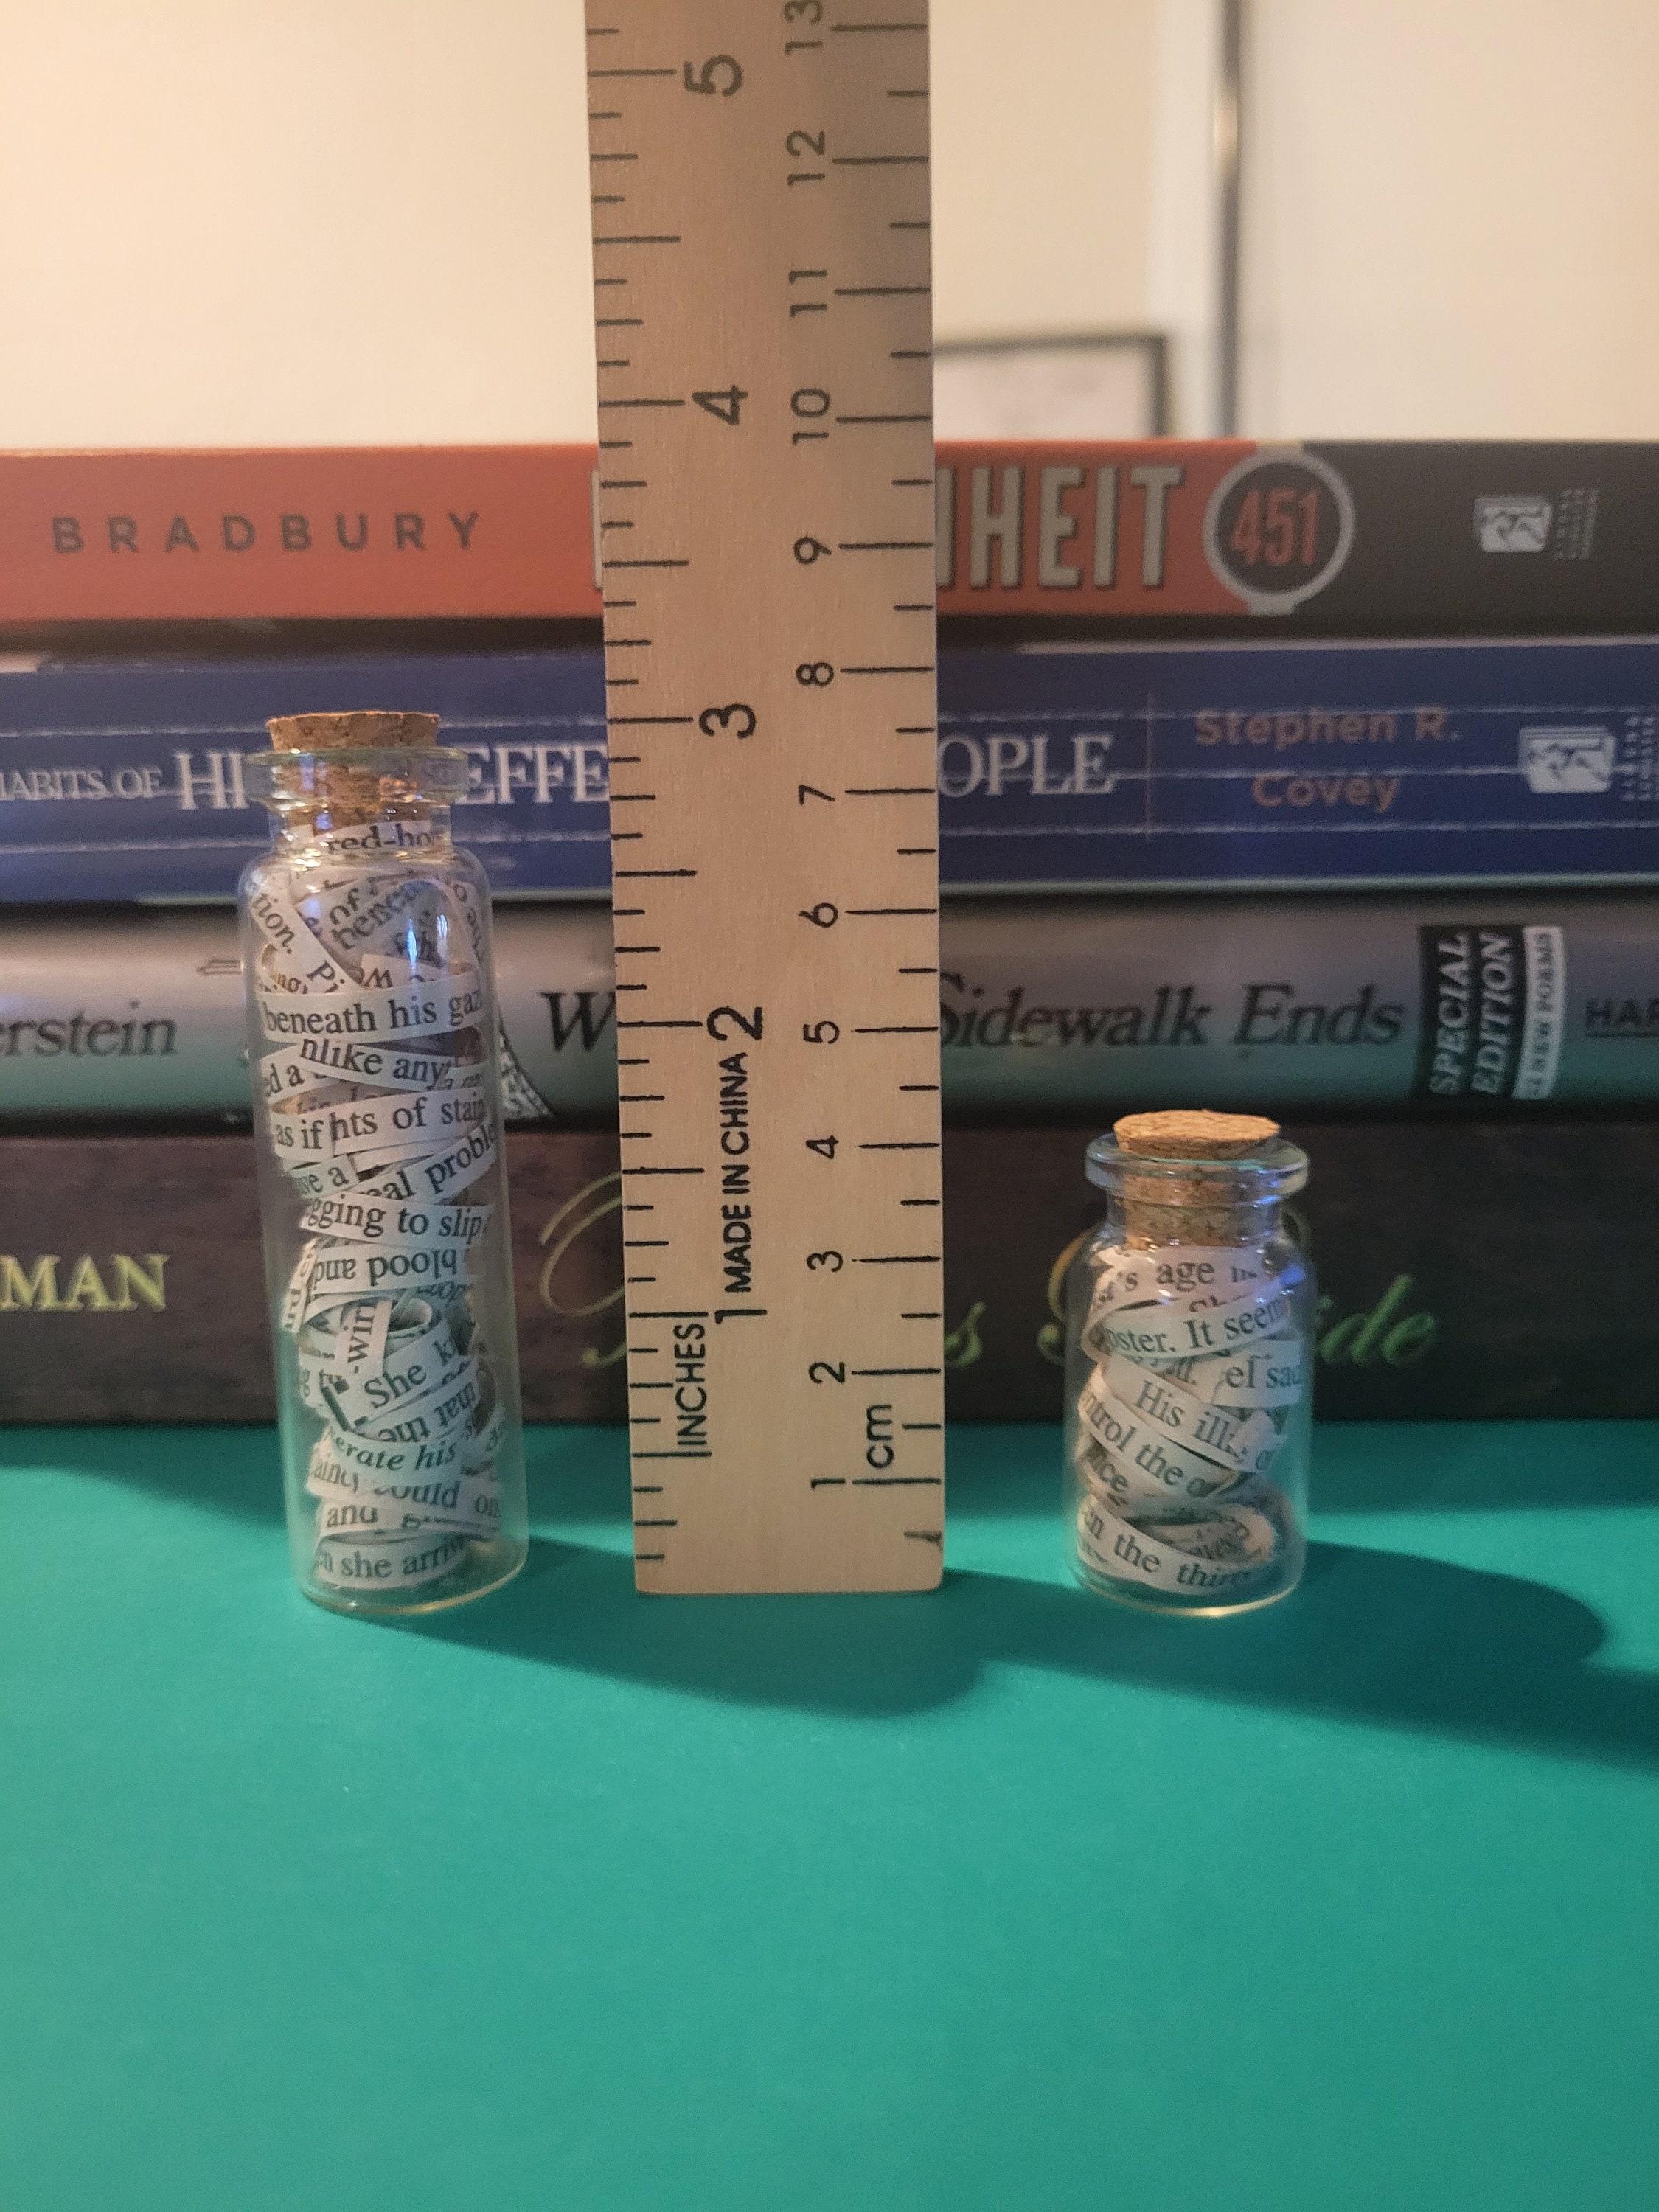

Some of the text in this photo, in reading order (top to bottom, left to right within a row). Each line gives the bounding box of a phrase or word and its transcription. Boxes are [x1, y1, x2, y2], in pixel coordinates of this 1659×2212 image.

[784, 0, 824, 55] 13
[684, 54, 745, 97] 5
[785, 129, 827, 187] 12
[788, 270, 828, 318] 11
[691, 385, 749, 426] 4
[790, 387, 831, 445] 10
[52, 512, 480, 554] BRADBURY
[1230, 487, 1321, 567] 451
[793, 535, 832, 566] 9
[796, 661, 835, 688] 8
[698, 703, 757, 740] 3
[1194, 707, 1397, 751] Stephen
[114, 765, 163, 799] OF
[798, 784, 836, 806] 7
[1251, 773, 1400, 813] Covey
[799, 902, 838, 928] 6
[262, 1001, 377, 1032] beneath
[389, 995, 438, 1029] his
[707, 1005, 764, 1041] 2
[1232, 980, 1405, 1049] Ends
[1428, 932, 1473, 1095] SPECIAL
[1471, 931, 1513, 1095] EDITION
[803, 1020, 841, 1045] 5
[392, 1096, 428, 1130] of
[300, 1119, 325, 1150] if
[806, 1135, 841, 1160] 4
[718, 1051, 753, 1294] MADE IN CHINA
[397, 1207, 430, 1236] to
[369, 1248, 458, 1287] blood
[808, 1250, 844, 1273] 3
[1155, 1262, 1216, 1293] age
[714, 1308, 768, 1325] 1
[1183, 1318, 1215, 1349] It
[364, 1364, 428, 1410] She
[674, 1322, 709, 1447] INCHES
[808, 1361, 847, 1385] 2
[1134, 1379, 1185, 1428] His
[866, 1403, 897, 1469] cm
[414, 1441, 459, 1471] his
[1134, 1441, 1186, 1487] the
[810, 1475, 847, 1489] 1
[340, 1551, 393, 1579] she
[1113, 1533, 1161, 1574] the
